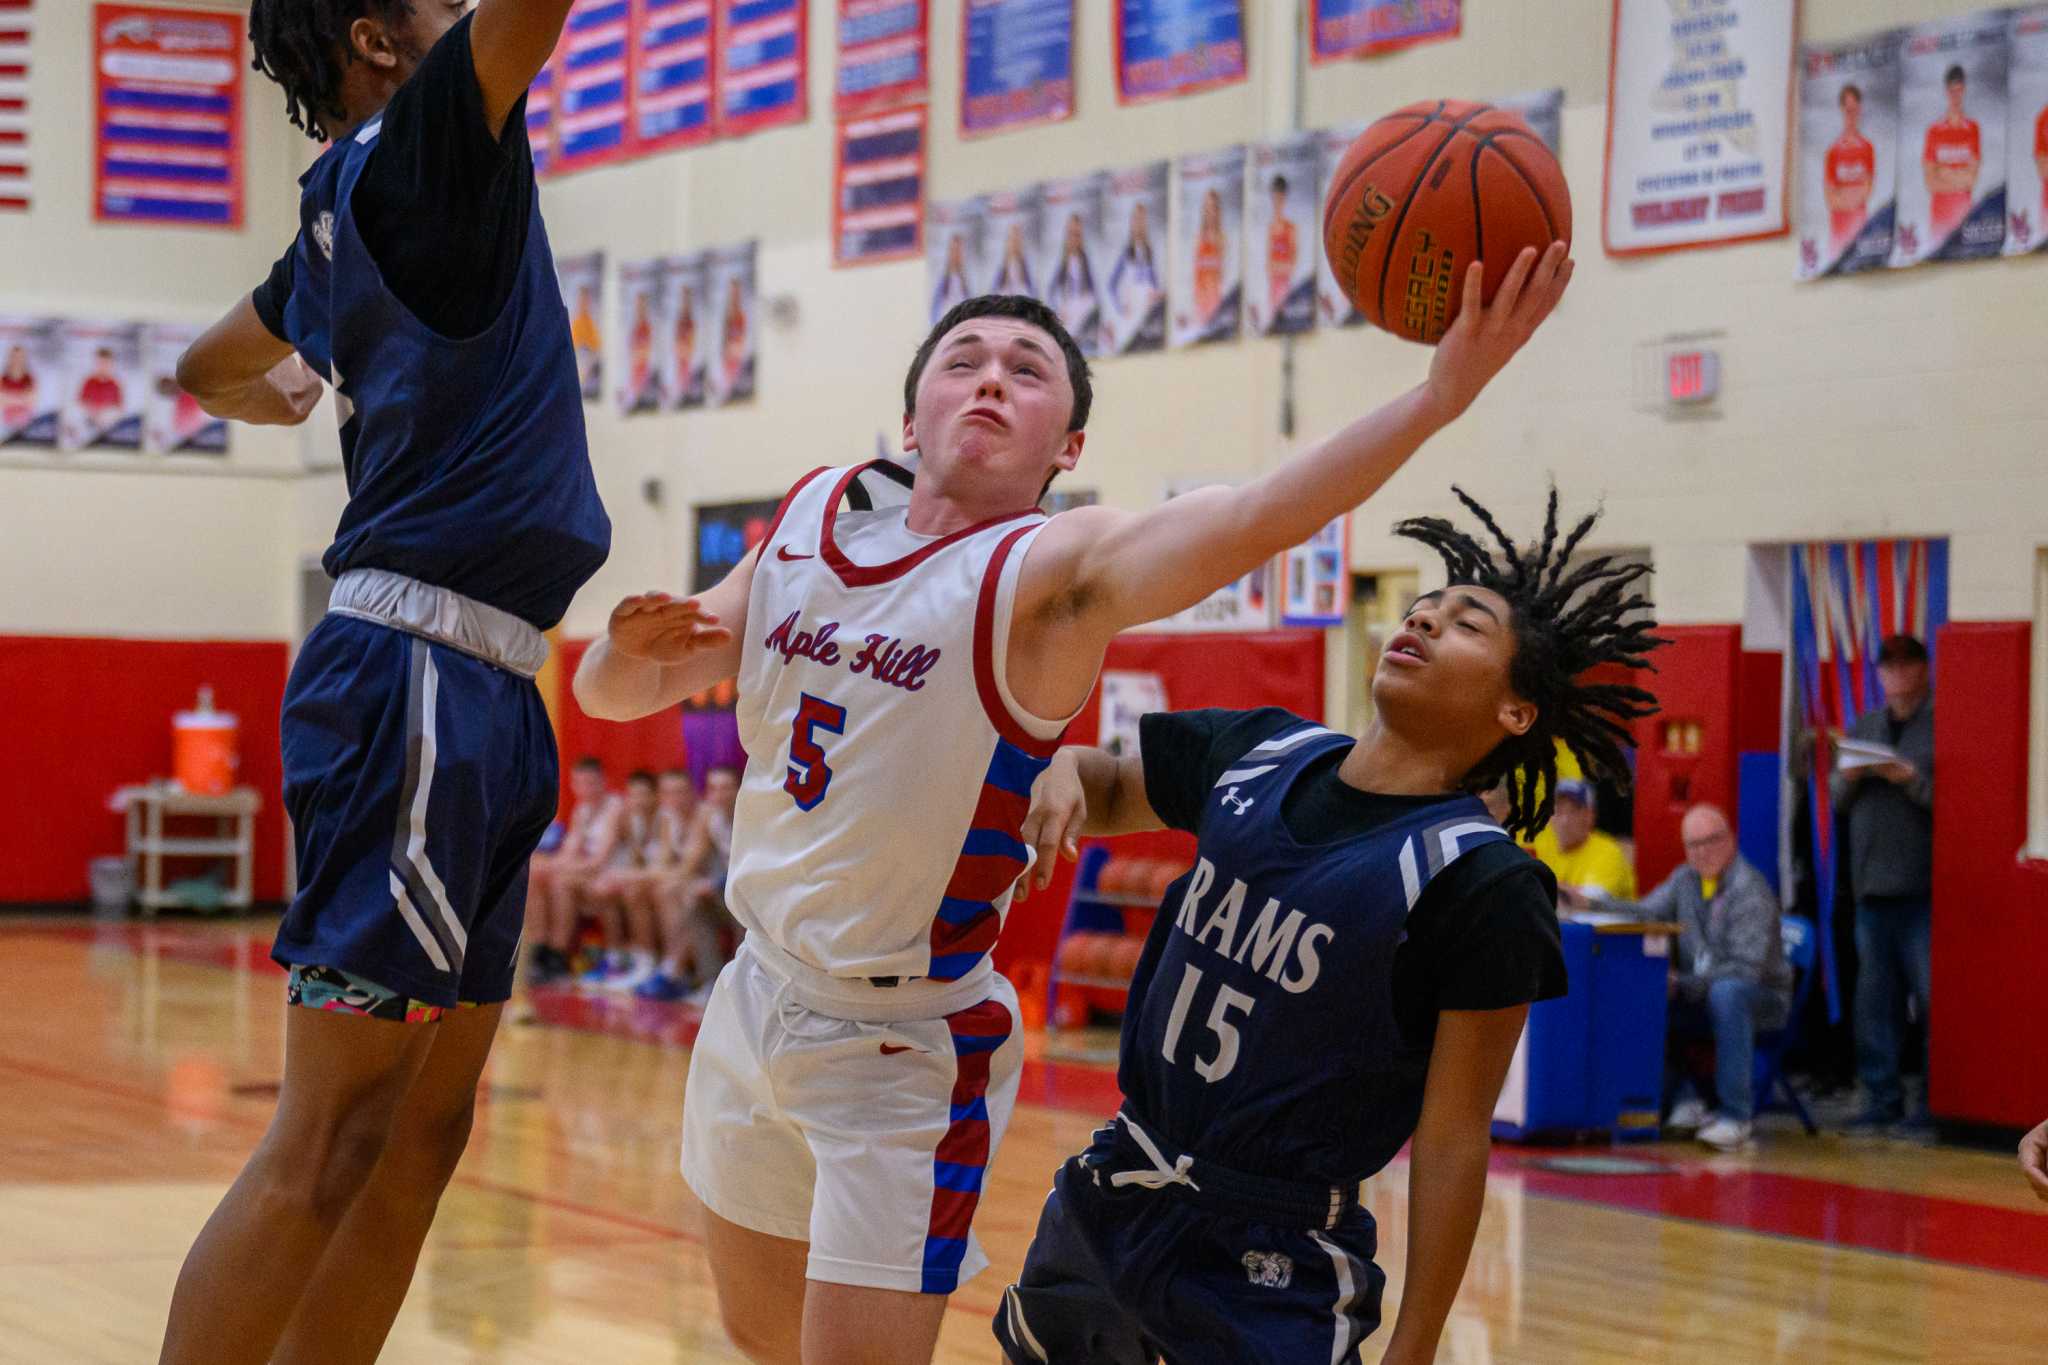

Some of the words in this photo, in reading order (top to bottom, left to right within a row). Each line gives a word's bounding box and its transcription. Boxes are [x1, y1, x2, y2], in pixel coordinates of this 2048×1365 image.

[849, 633, 941, 692] Hill
[783, 691, 847, 813] 5
[1175, 856, 1335, 994] RAMS
[1161, 961, 1256, 1084] 15
